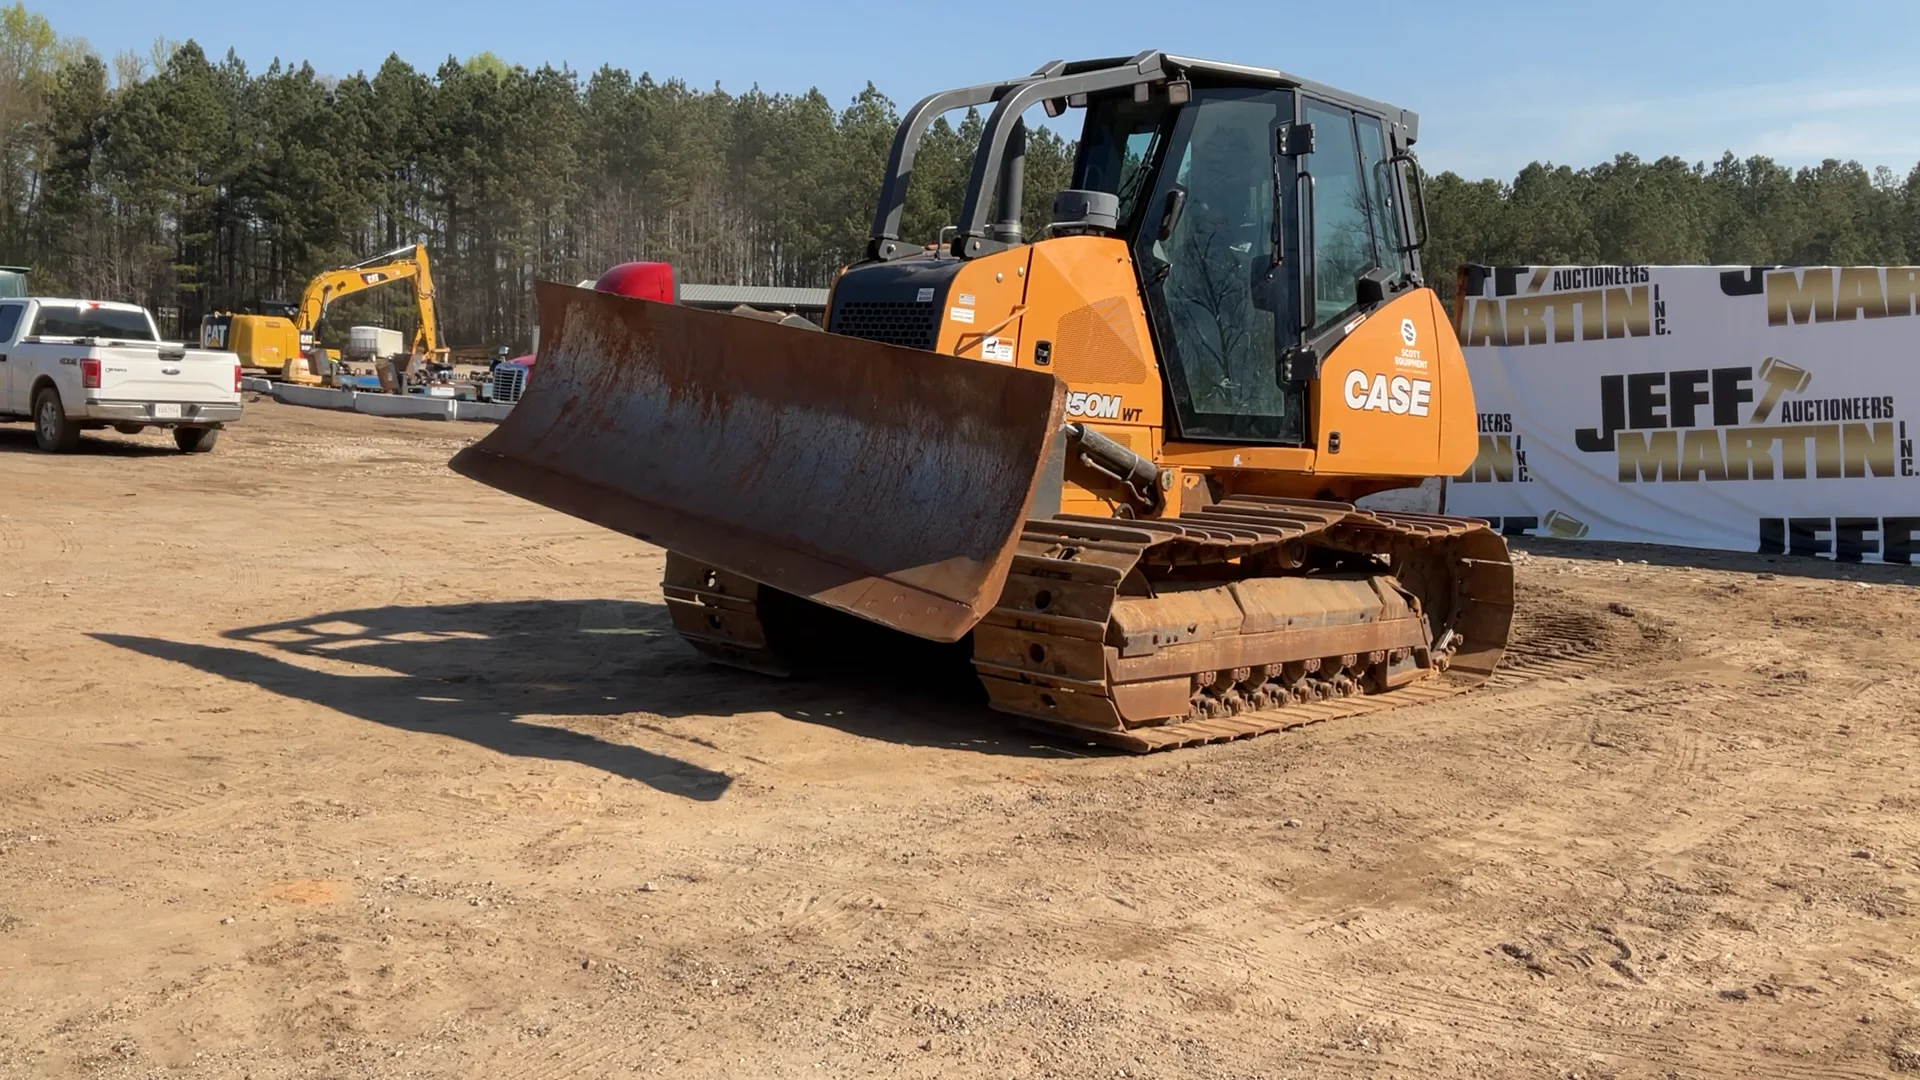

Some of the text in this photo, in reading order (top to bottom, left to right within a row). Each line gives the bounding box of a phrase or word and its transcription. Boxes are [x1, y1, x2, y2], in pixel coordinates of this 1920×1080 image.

[367, 273, 380, 285] CAT
[1553, 266, 1649, 291] AUCTIONEERS
[1460, 286, 1651, 347] ARTIN
[1653, 283, 1672, 335] INC.
[205, 325, 227, 348] CAT
[300, 334, 313, 345] CAT
[1394, 356, 1428, 369] EQUIPMENT
[1401, 348, 1421, 359] SCOTT
[1344, 369, 1432, 417] CASE
[1122, 407, 1143, 422] WT
[1477, 412, 1513, 433] EERS
[1575, 367, 1753, 453] JEFF
[1780, 395, 1895, 424] AUCTIONEERS
[1515, 434, 1534, 483] INC.
[1617, 421, 1896, 483] MARTIN
[1899, 420, 1920, 477] INC.
